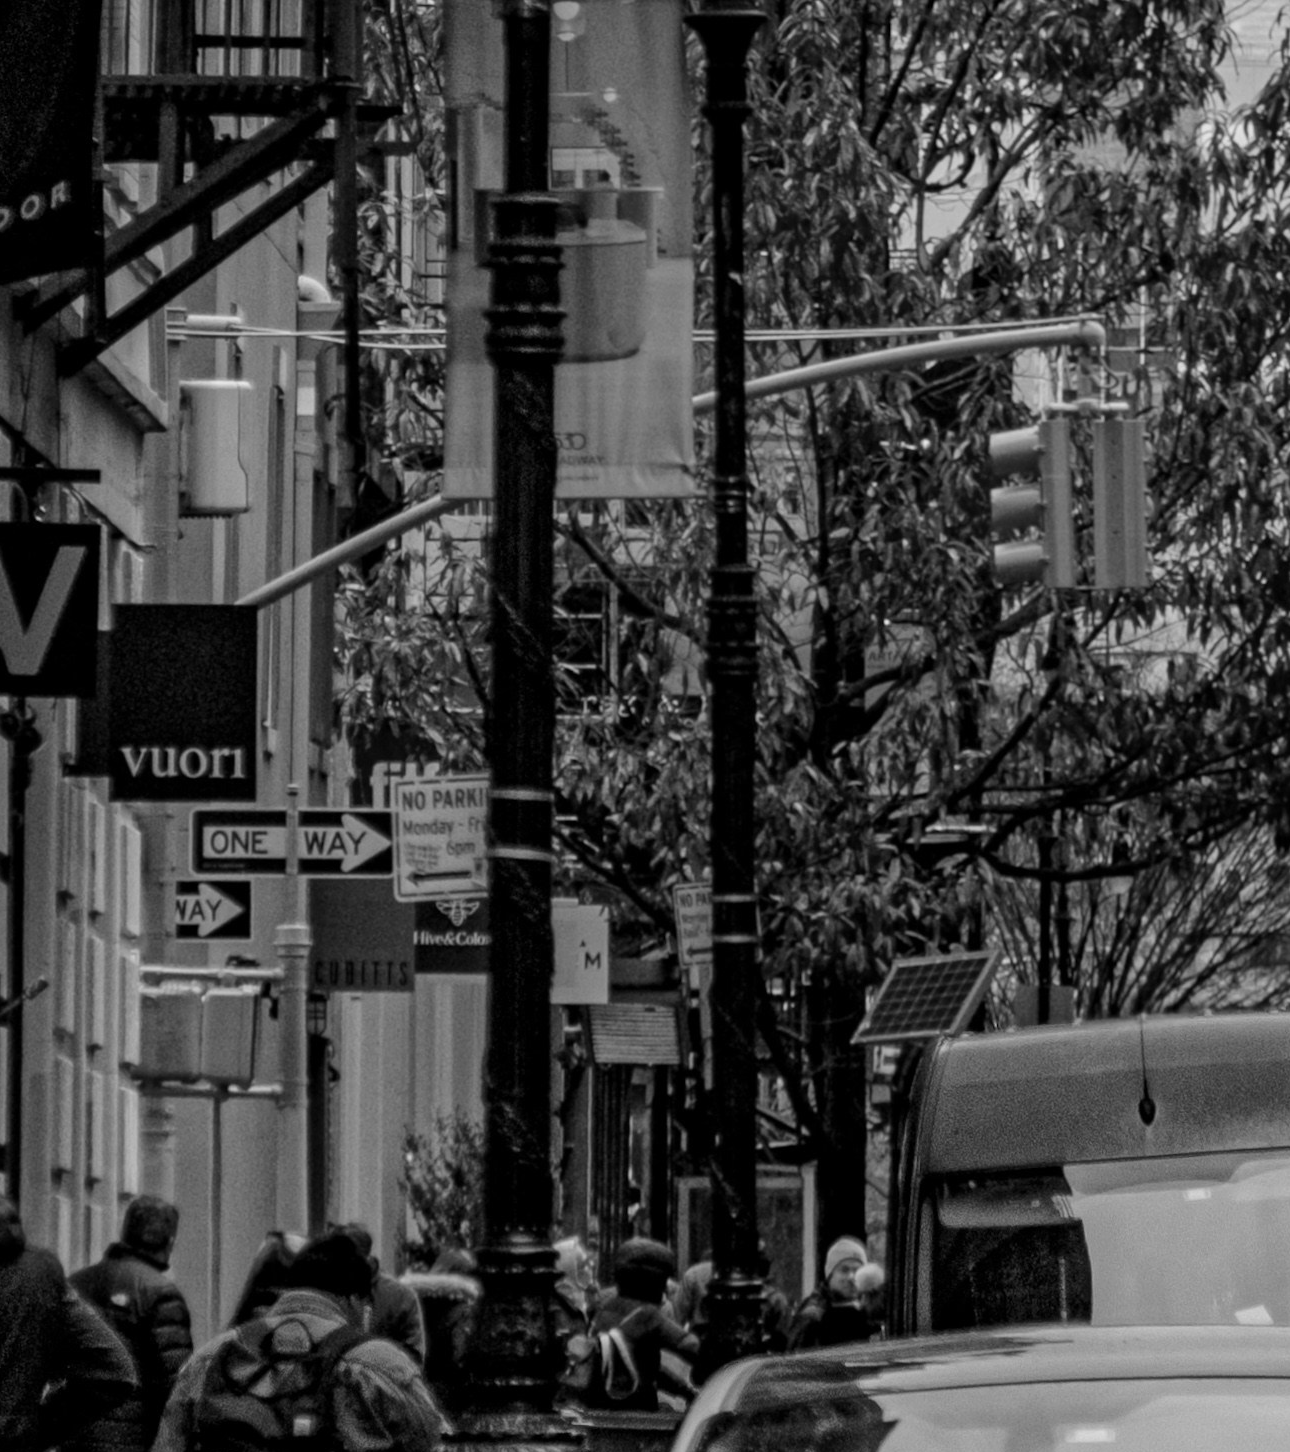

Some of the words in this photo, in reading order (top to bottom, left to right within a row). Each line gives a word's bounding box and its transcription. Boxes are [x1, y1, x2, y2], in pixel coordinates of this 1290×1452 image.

[402, 791, 427, 811] NO
[432, 786, 489, 810] PARKI
[402, 818, 455, 837] Monday
[467, 817, 486, 833] Fr
[210, 830, 269, 855] ONE
[303, 830, 368, 856] WAY
[314, 960, 409, 987] CUBITTS
